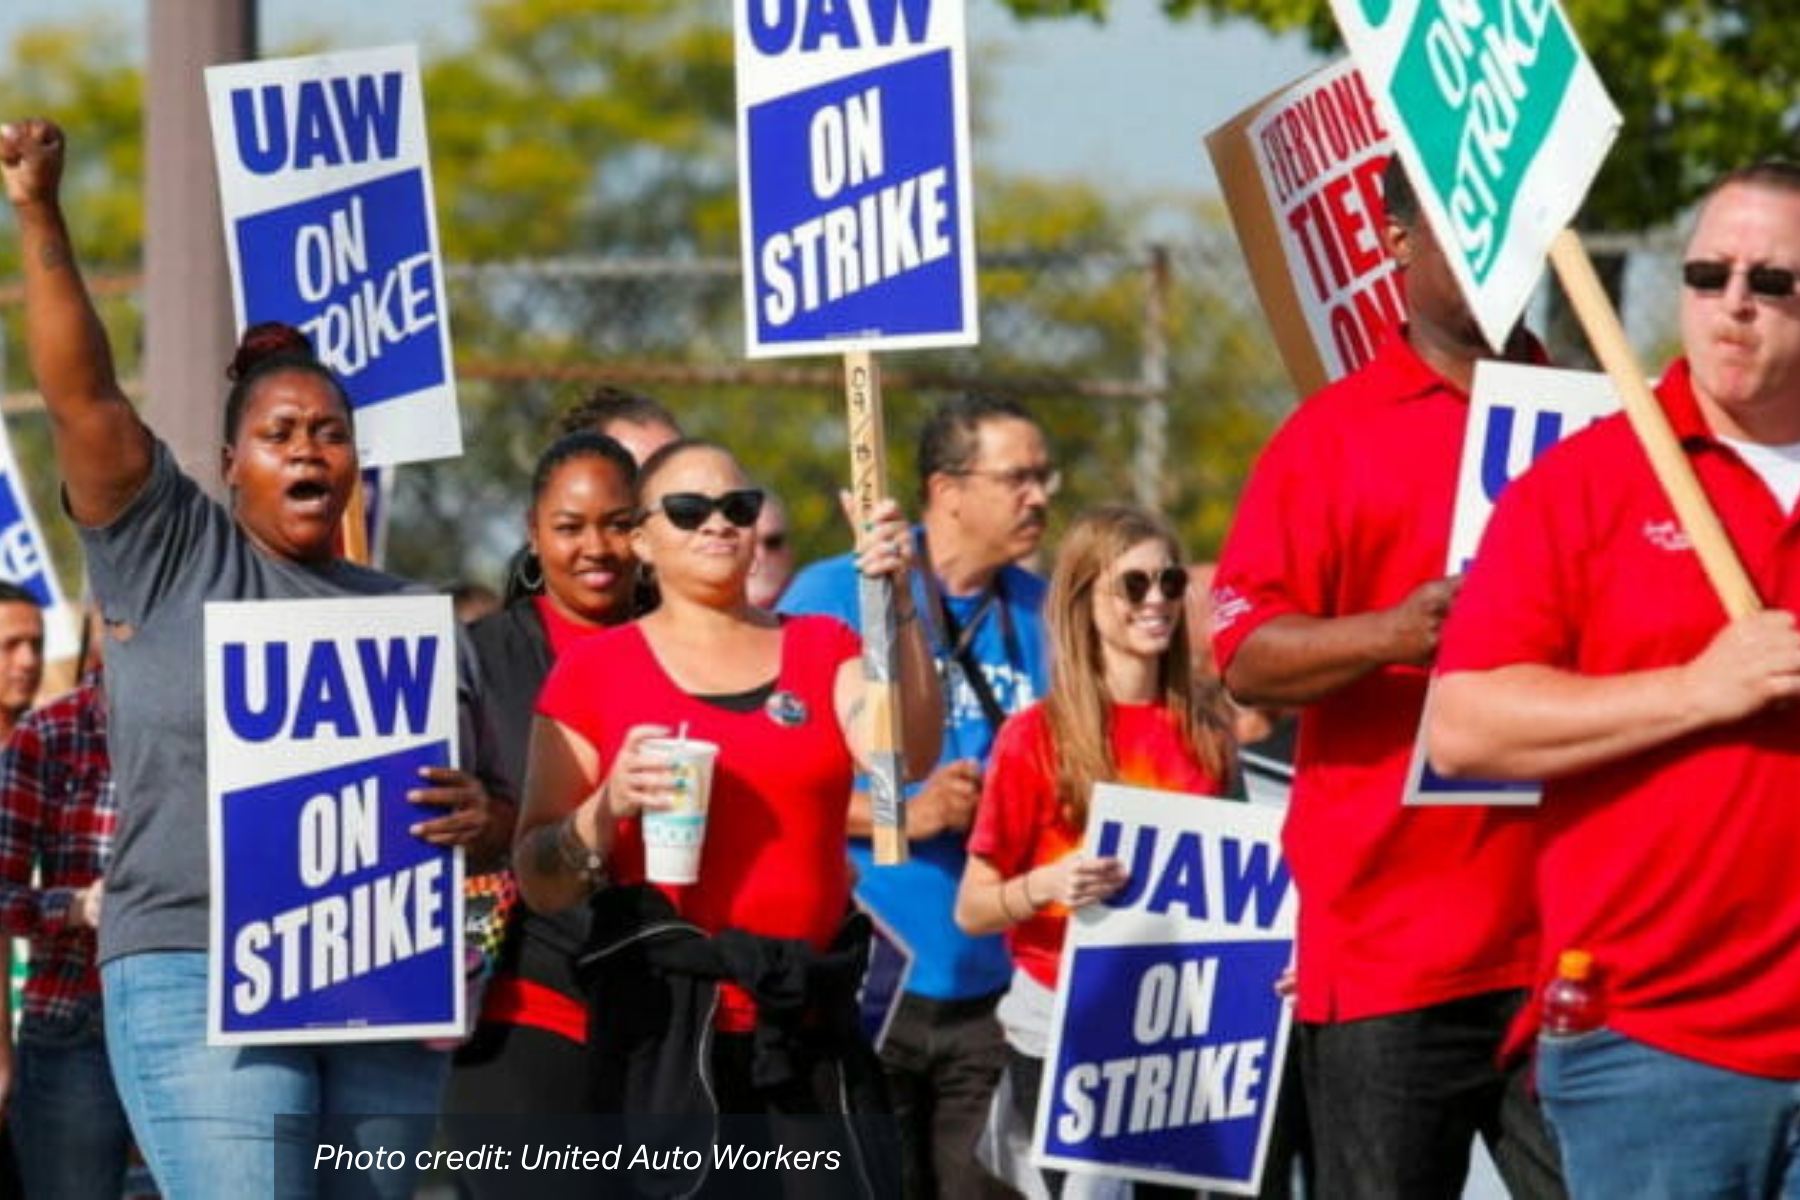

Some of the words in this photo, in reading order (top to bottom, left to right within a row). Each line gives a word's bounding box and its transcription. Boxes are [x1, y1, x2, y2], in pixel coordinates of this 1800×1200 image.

[231, 71, 403, 176] UAW
[809, 86, 884, 200] ON
[295, 195, 367, 302] ON
[761, 167, 951, 326] STRIKE
[223, 635, 438, 743] UAW
[299, 776, 379, 888] ON
[1095, 820, 1291, 930] UAW
[233, 858, 444, 1015] STRIKE
[1133, 956, 1219, 1045] ON
[1056, 1038, 1267, 1145] STRIKE
